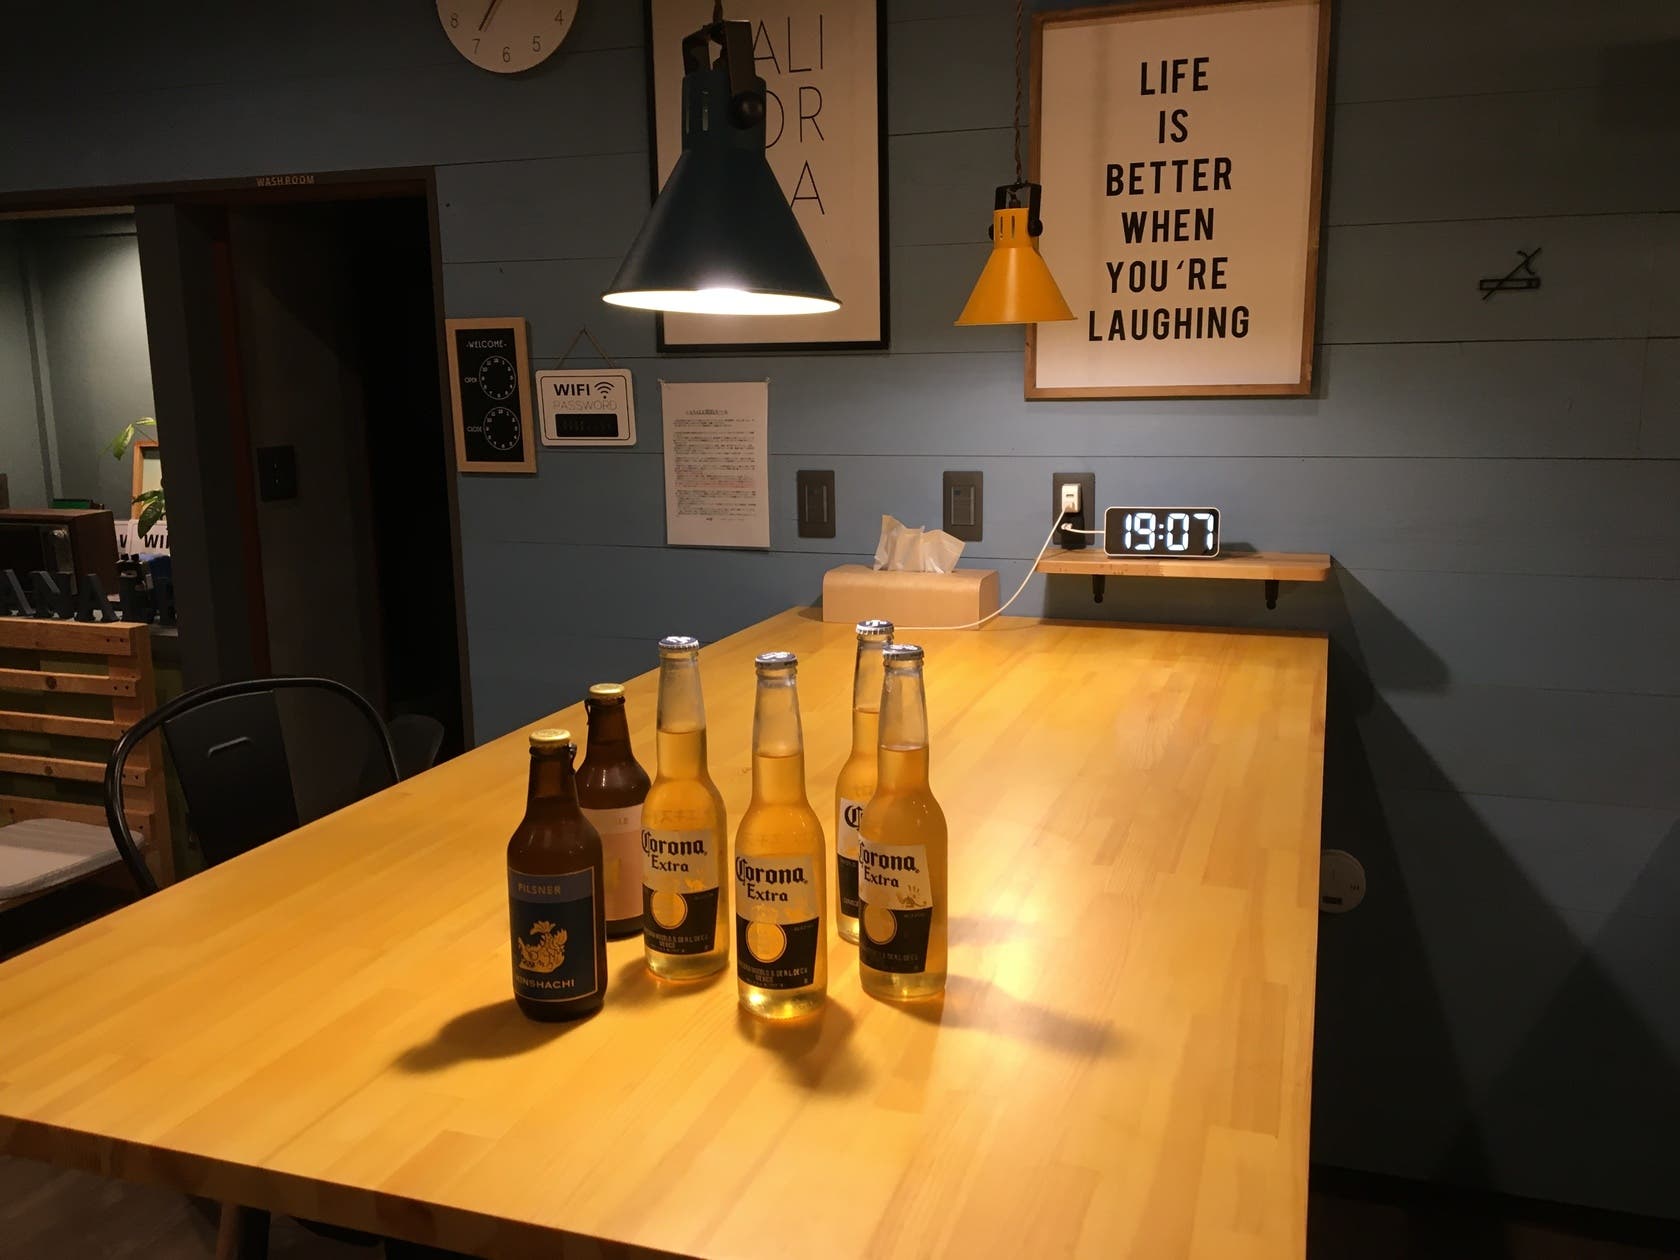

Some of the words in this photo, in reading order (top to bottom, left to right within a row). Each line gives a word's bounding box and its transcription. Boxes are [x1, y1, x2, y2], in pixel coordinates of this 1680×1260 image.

[450, 12, 459, 28] 8
[554, 9, 564, 25] 4
[472, 38, 480, 54] 7
[532, 35, 541, 52] 5
[753, 14, 823, 74] ALI
[502, 46, 511, 63] 6
[1140, 56, 1210, 96] LIFE
[1158, 108, 1189, 144] IS
[255, 175, 315, 187] WASHROOM
[1105, 157, 1232, 197] BETTER
[1120, 207, 1215, 245] WHEN
[1105, 256, 1229, 294] YOU'RE
[1088, 305, 1250, 342] LAUGHING
[553, 383, 591, 397] WIFI
[552, 399, 619, 411] PASSWORD
[1124, 512, 1214, 551] 19:07
[641, 829, 706, 857] Corona
[651, 855, 689, 873] Extra
[736, 856, 805, 885] Corona
[864, 868, 899, 888] Extra
[518, 882, 561, 895] PILSNER
[747, 883, 788, 902] Extra
